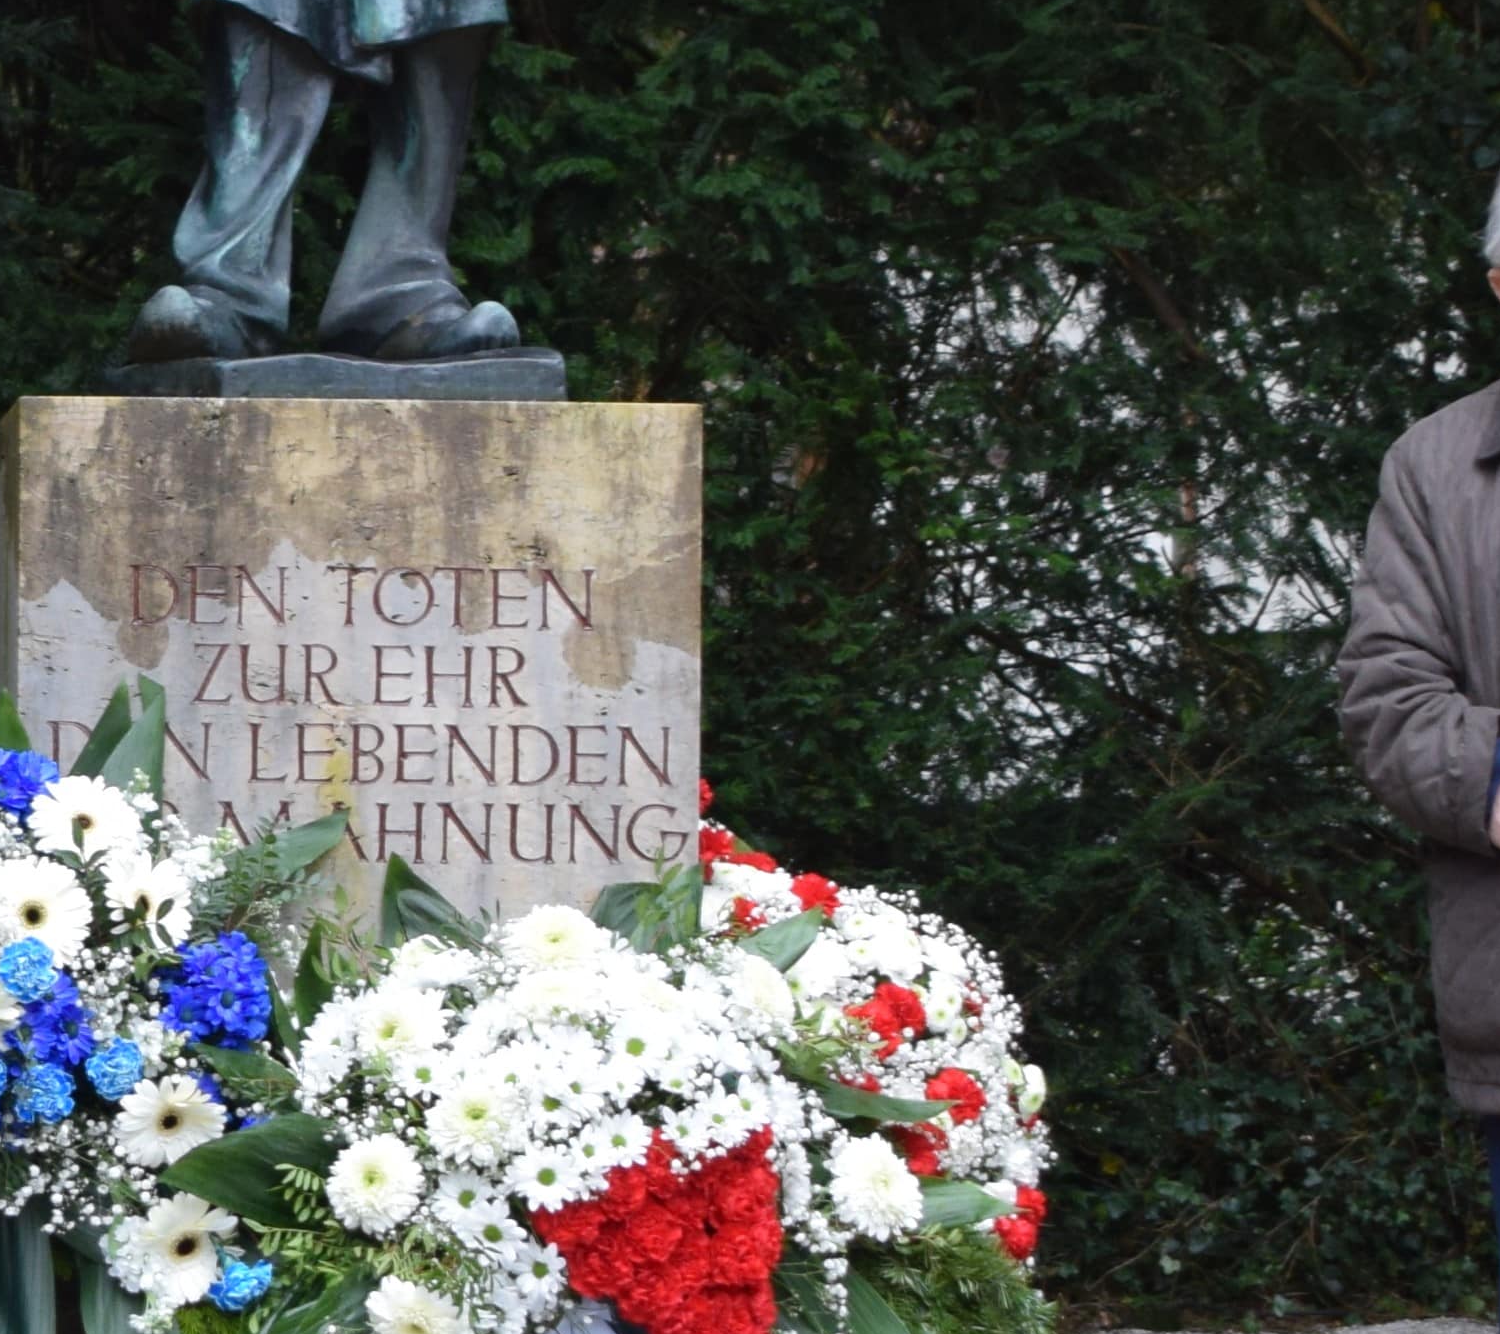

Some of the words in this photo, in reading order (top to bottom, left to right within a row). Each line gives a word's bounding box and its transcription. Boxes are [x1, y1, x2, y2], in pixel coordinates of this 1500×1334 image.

[129, 564, 288, 627] DEN
[326, 564, 595, 631] TOTEN
[191, 643, 345, 705] ZUR
[372, 644, 527, 708] EHR
[48, 720, 212, 783] DN
[248, 722, 673, 787] LEBENDEN
